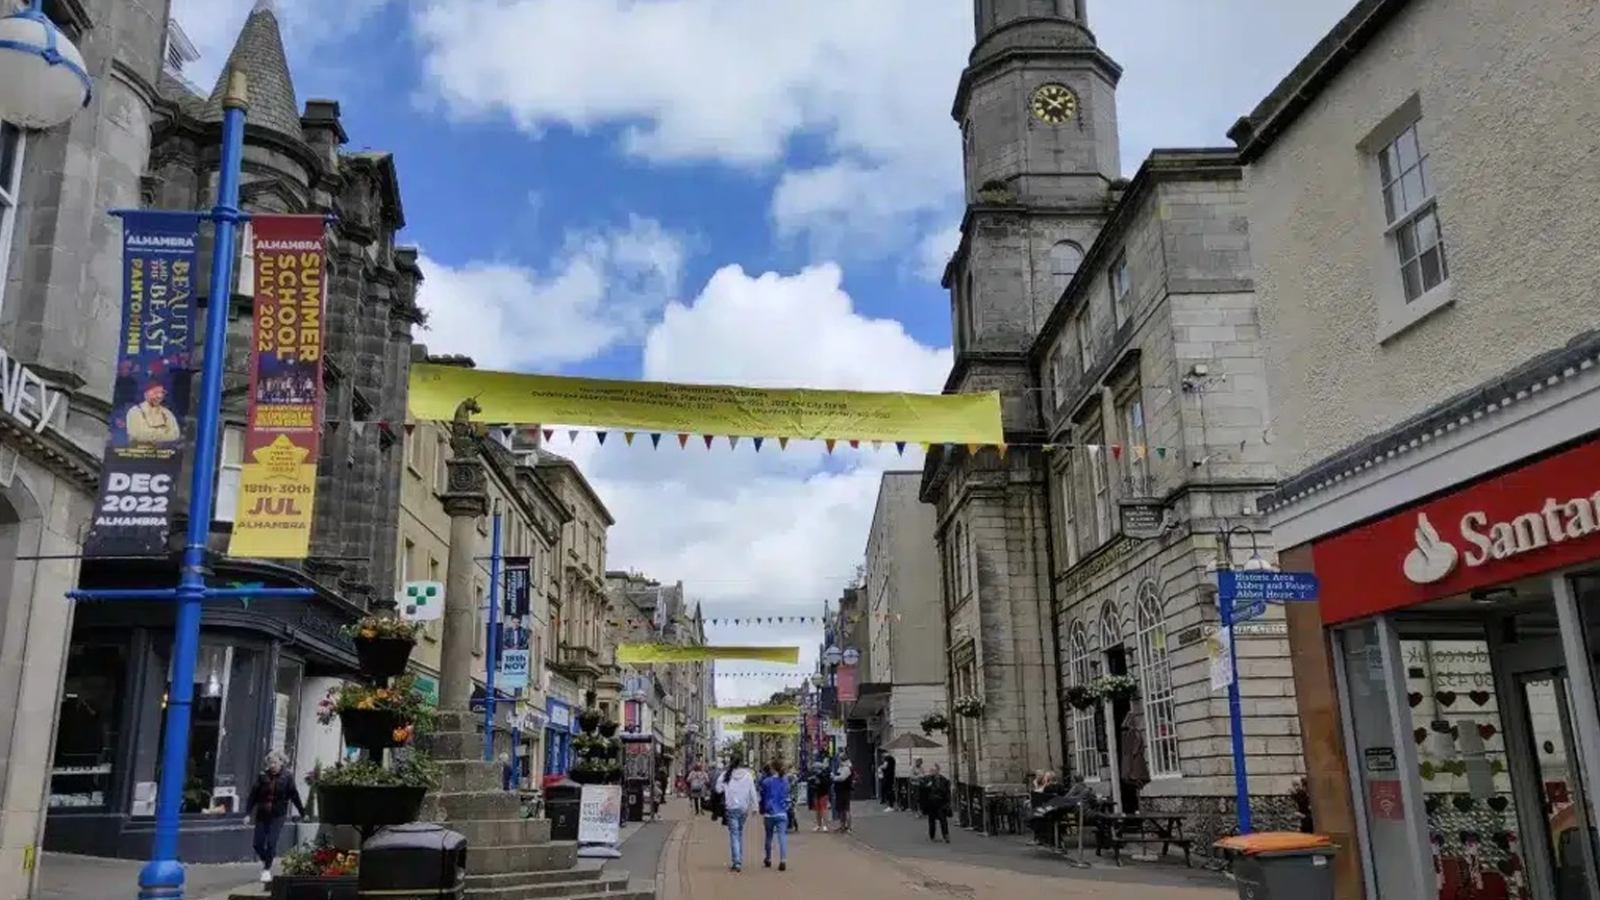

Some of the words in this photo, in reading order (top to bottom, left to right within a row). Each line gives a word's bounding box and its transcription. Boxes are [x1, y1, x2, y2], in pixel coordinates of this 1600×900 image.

[127, 235, 194, 247] ALHAMBRA
[256, 240, 322, 250] ALHAMBRA
[258, 251, 274, 297] JULY
[126, 257, 144, 354] PANTOMIME
[168, 258, 190, 347] BEAUTY
[277, 253, 297, 360] SCHOOL
[299, 252, 321, 362] SUMMER
[145, 282, 168, 355] BEAST
[258, 304, 274, 351] 2022
[107, 472, 171, 493] DEC
[102, 494, 169, 512] 2022
[247, 497, 302, 516] JUL
[95, 515, 168, 526] ALHAMBRA
[237, 521, 307, 529] ALHAMBRA
[1235, 573, 1270, 581] Historic
[1236, 581, 1264, 590] Abbey
[1285, 582, 1314, 590] Palace
[1266, 590, 1294, 598] House
[504, 662, 526, 670] NOV
